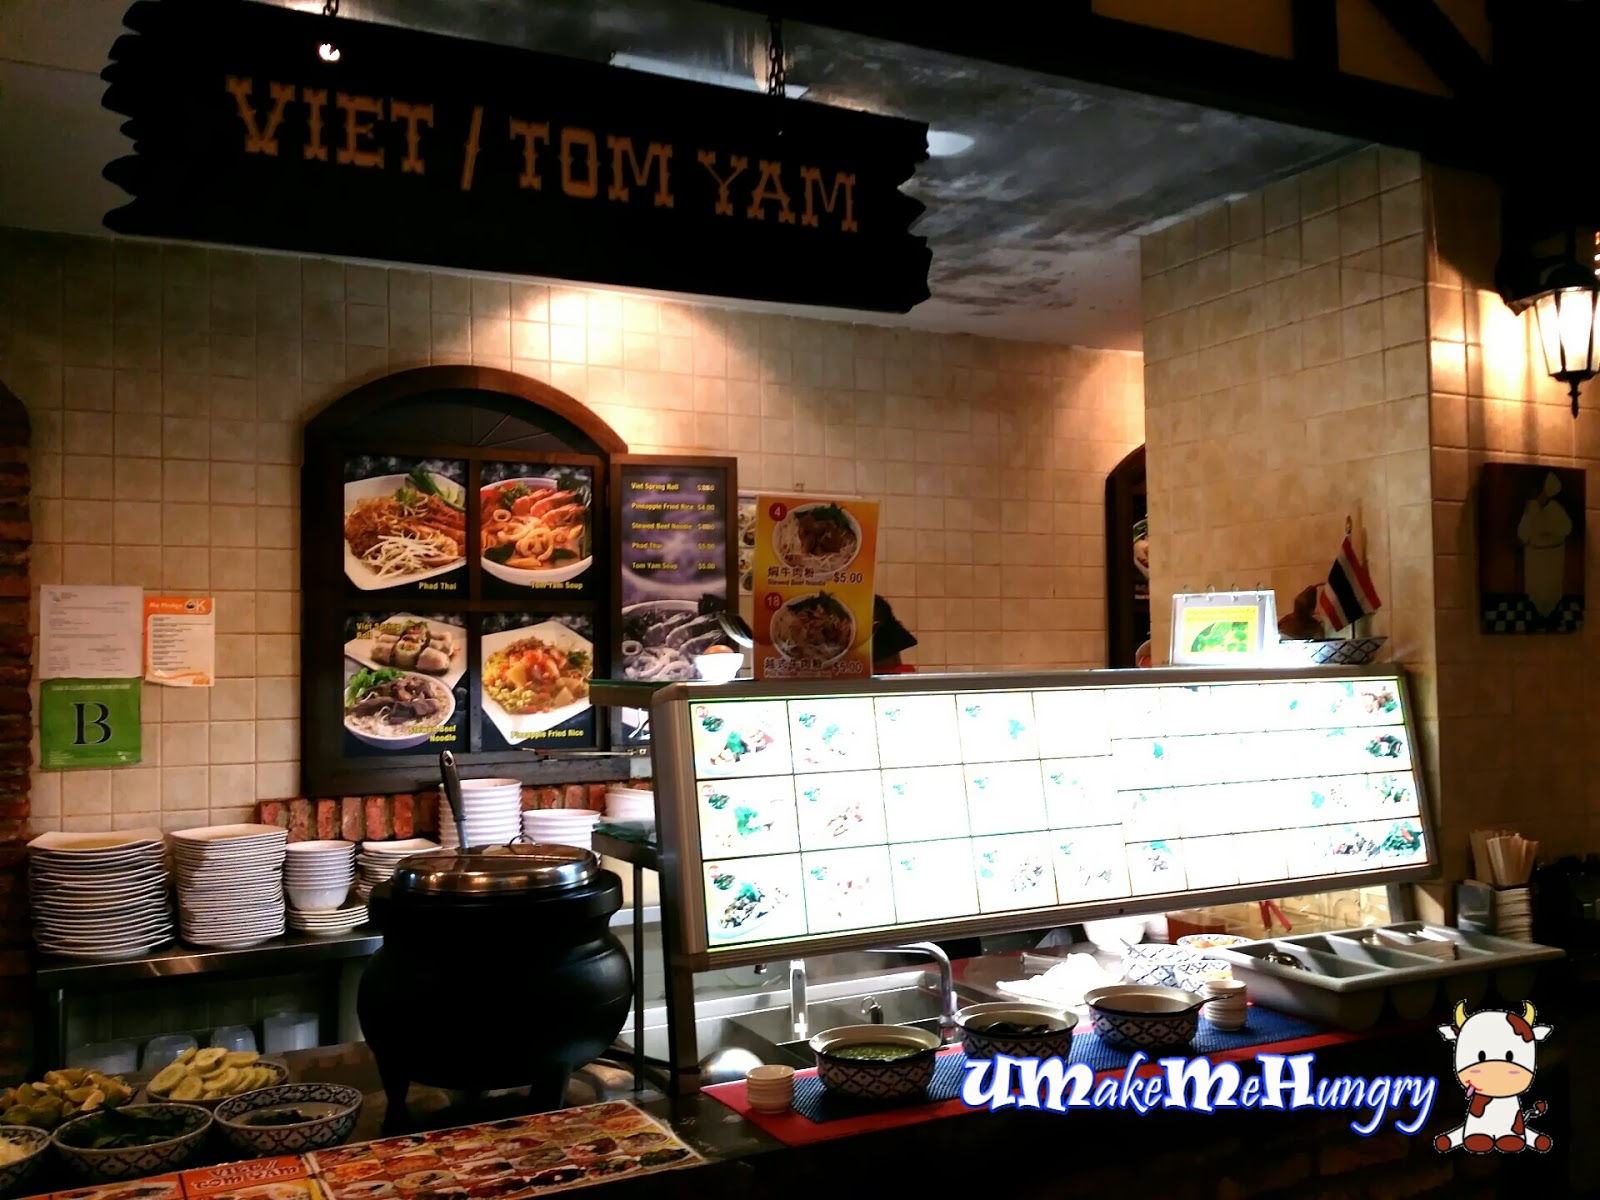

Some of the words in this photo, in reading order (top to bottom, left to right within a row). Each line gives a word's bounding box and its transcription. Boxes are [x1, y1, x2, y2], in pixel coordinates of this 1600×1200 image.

[225, 75, 434, 175] VIET
[460, 105, 484, 191] /
[509, 116, 675, 208] TOM
[697, 149, 859, 233] YAM
[631, 482, 644, 490] Viet
[644, 482, 666, 491] Spring
[666, 483, 679, 491] Roll
[631, 502, 662, 511] Pineapple
[663, 503, 680, 511] Fried
[774, 506, 781, 516] 4
[631, 522, 655, 530] Stewed
[631, 542, 648, 550] Phad
[632, 562, 646, 570] Tom
[647, 562, 661, 570] Yam
[833, 572, 862, 584] $5.00
[418, 582, 438, 590] Phad
[440, 582, 457, 591] Thai
[530, 582, 547, 590] Tom
[548, 582, 564, 590] Yam
[565, 582, 584, 590] Soup
[356, 622, 372, 630] Viet
[374, 622, 401, 632] Spring
[356, 631, 373, 639] Roll
[73, 701, 113, 746] B
[440, 725, 457, 733] Beef
[429, 734, 457, 743] Noodle
[510, 730, 547, 741] Pineapple
[549, 729, 566, 738] Fried
[567, 729, 584, 737] Rice
